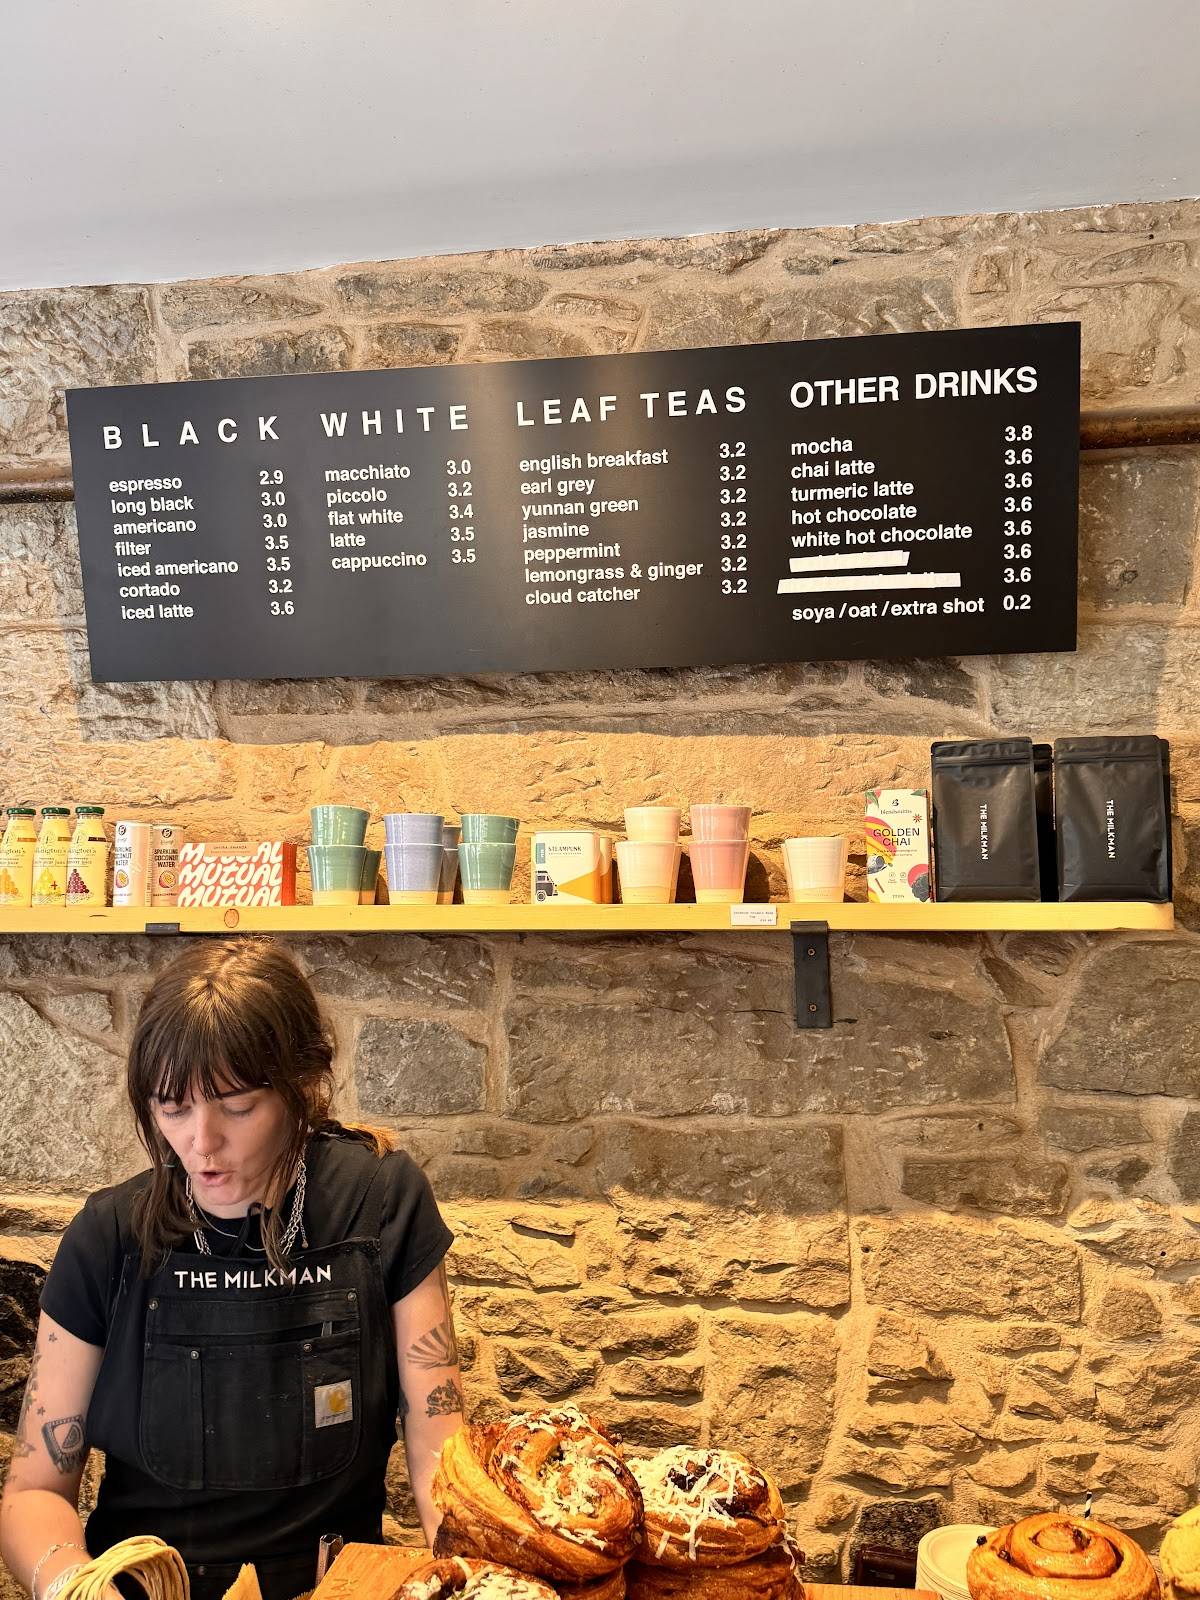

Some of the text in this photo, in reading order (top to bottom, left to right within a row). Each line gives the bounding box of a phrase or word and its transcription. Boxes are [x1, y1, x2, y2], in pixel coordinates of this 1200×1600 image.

[790, 366, 1037, 408] OTHER DRINKS
[517, 387, 745, 426] LEAF TEAS
[103, 416, 279, 449] BLACK
[320, 405, 468, 437] WHITE
[791, 425, 1032, 455] mocha 3.8
[325, 459, 471, 482] macchiato 3.0
[519, 442, 745, 474] english breakfast 3.2
[791, 448, 1032, 479] chai latte 3.6
[109, 470, 283, 495] espresso 2.9
[521, 465, 746, 496] earl grey 3.2
[791, 472, 1032, 502] turmeric latte 3.6
[111, 491, 285, 516] long black 3.0
[327, 481, 472, 507] piccolo 3.2
[521, 488, 746, 520] yunnan green 3.2
[328, 504, 474, 525] flat white 3.4
[792, 496, 1032, 524] hot chocolate 3.6
[114, 513, 287, 535] americano 3.0
[330, 526, 474, 547] latte 3.5
[523, 511, 746, 543] jasmine 3.2
[791, 520, 1032, 547] white hot chocolate 3.6
[115, 535, 289, 556] filter 3.5
[524, 534, 746, 565] peppermint 3.2
[1004, 543, 1031, 559] 3.6
[117, 557, 291, 577] iced americano 3.5
[332, 548, 476, 572] cappuccino 3.5
[525, 556, 747, 584] lemongrass & ginger 3.2
[1004, 567, 1031, 583] 3.6
[120, 579, 293, 598] cortado 3.2
[525, 579, 747, 605] cloud catcher 3.2
[121, 601, 294, 619] iced latte 3.6
[943, 598, 984, 613] shot
[1003, 594, 1031, 610] 0.2
[873, 827, 920, 837] GOLDEN
[882, 837, 911, 847] CHAI
[979, 803, 989, 860] THE MILKMAN
[1106, 799, 1116, 859] THE MILKMAN
[174, 1264, 333, 1289] THE MILKMAN
